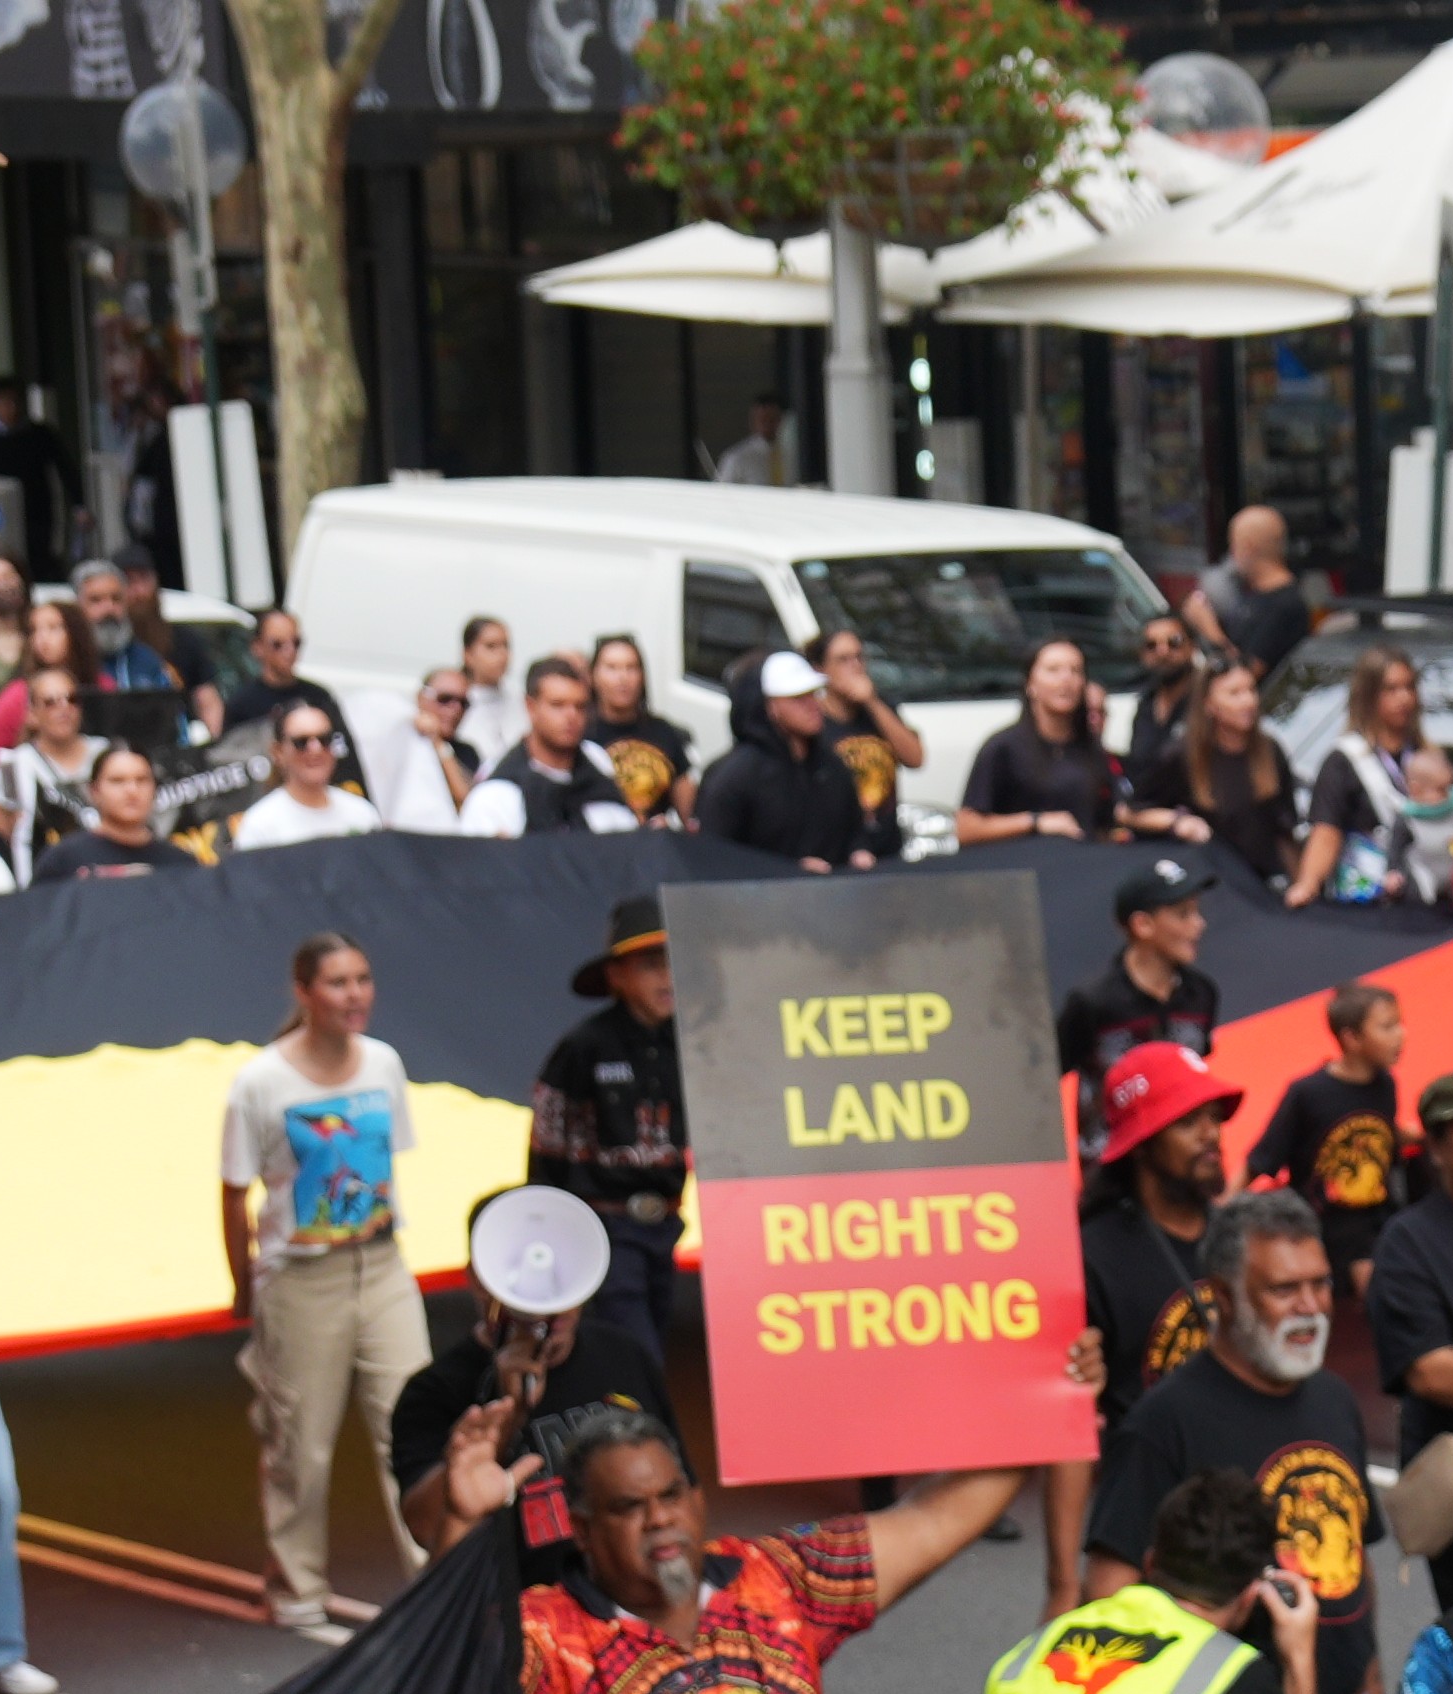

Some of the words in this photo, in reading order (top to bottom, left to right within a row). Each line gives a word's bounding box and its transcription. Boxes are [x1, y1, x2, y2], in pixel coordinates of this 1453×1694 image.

[778, 992, 952, 1059] KEEP
[784, 1079, 970, 1149] LAND
[762, 1192, 1019, 1266] RIGHTS
[756, 1278, 1040, 1355] STRONG
